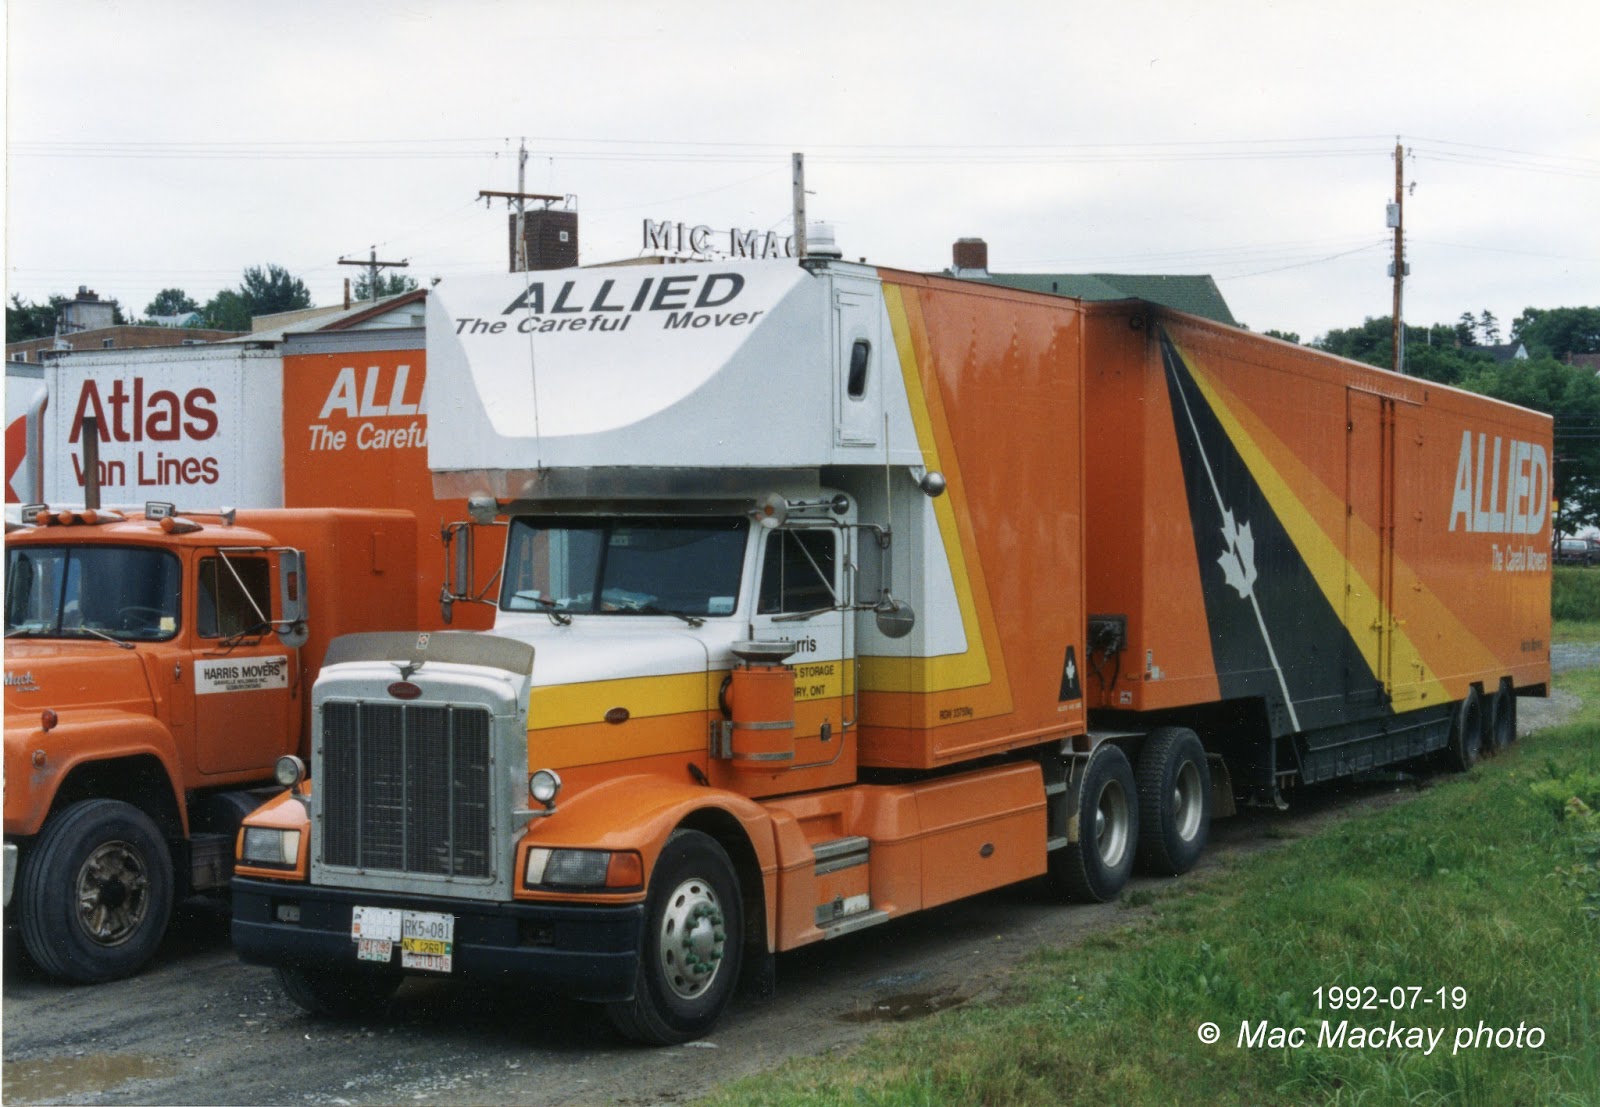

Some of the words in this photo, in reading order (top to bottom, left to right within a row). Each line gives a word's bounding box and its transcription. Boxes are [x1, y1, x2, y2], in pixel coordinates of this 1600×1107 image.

[643, 218, 713, 254] MIC
[501, 272, 745, 315] ALLIED
[455, 318, 507, 335] The
[517, 313, 632, 334] Careful
[663, 310, 764, 330] Mover
[68, 377, 219, 443] Atlas
[309, 424, 347, 450] The
[138, 451, 219, 485] Lines
[1448, 430, 1548, 535] ALLIED
[1492, 544, 1503, 571] The
[780, 635, 816, 653] rris
[204, 666, 239, 680] HARRIS
[242, 664, 280, 678] MOVERS
[799, 665, 834, 678] STORAGE
[810, 685, 825, 696] ONT
